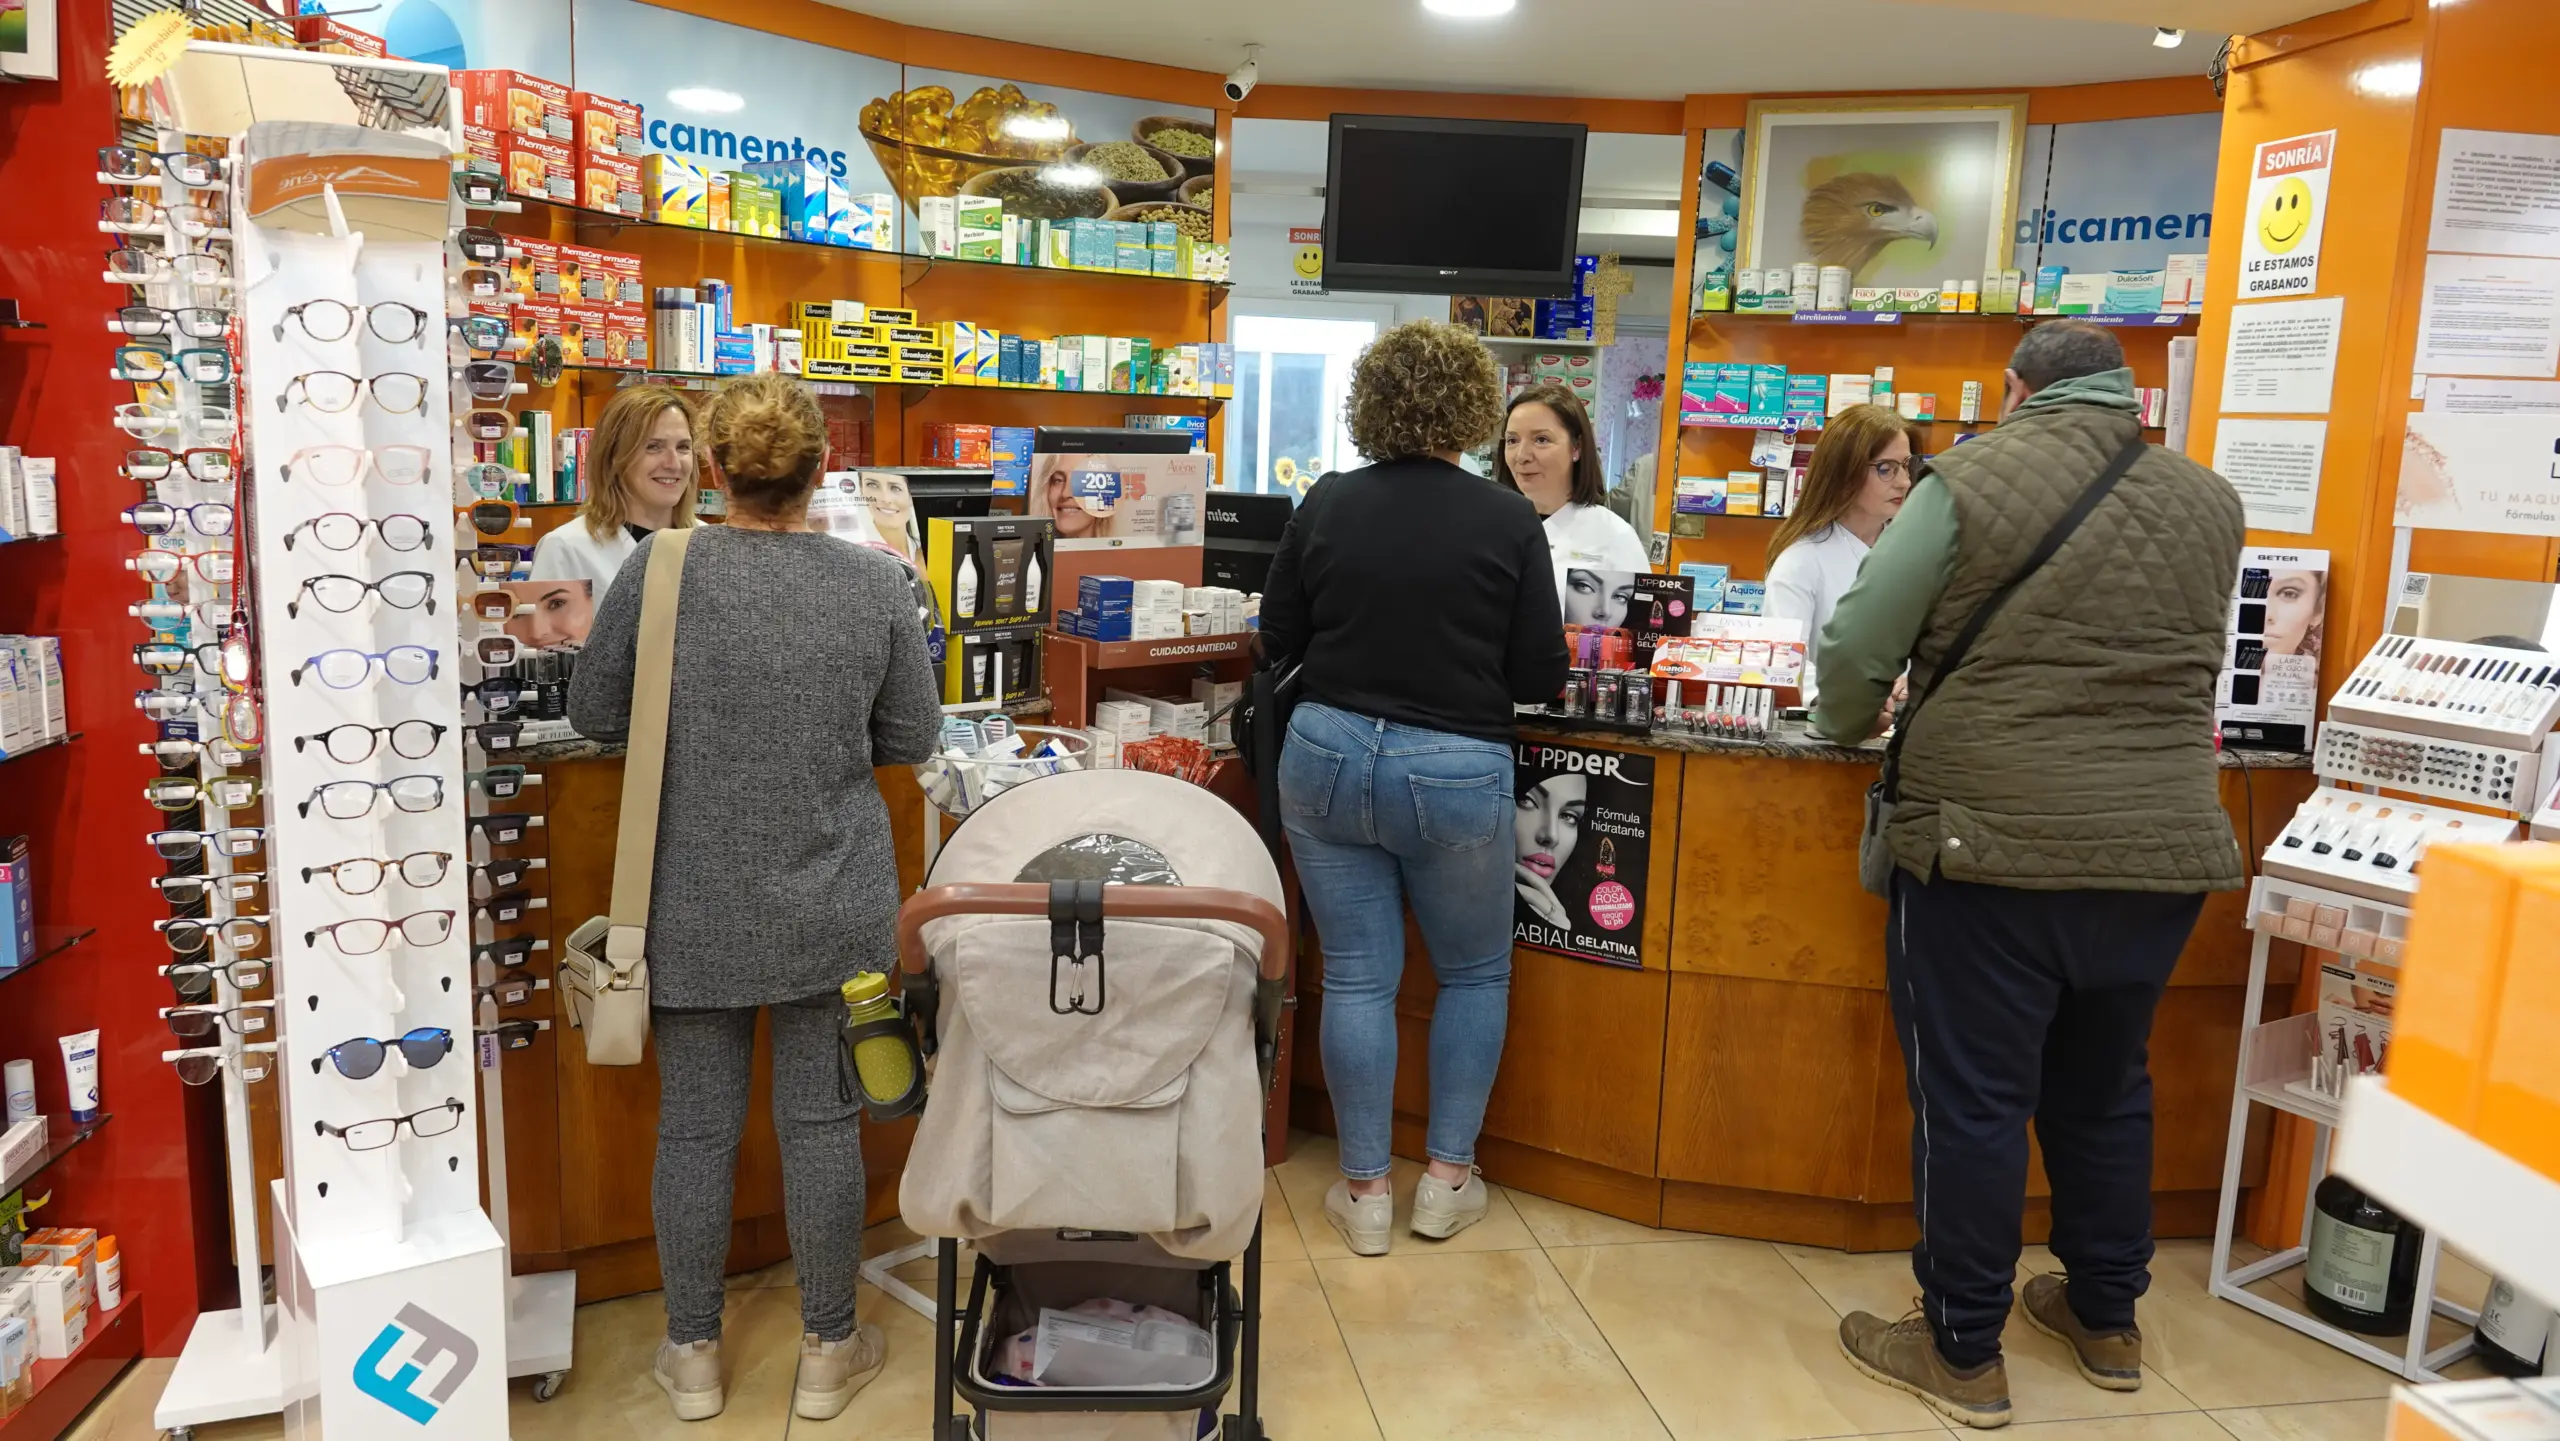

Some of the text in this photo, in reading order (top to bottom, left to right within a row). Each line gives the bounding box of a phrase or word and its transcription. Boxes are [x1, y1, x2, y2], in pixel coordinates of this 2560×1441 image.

[144, 20, 182, 58] presbicia
[326, 21, 383, 49] ThermaCare
[515, 73, 568, 97] ThermaCare
[590, 95, 638, 116] ThermaCare
[635, 100, 848, 178] icamentos
[516, 135, 570, 158] ThermaCare
[2265, 143, 2324, 171] SONRÍA
[592, 154, 639, 173] ThermaCare
[1293, 231, 1320, 241] SONR
[513, 238, 558, 253] ThermaCare
[561, 246, 603, 260] ThermaCare
[603, 255, 641, 266] ermaCare
[2248, 255, 2314, 272] LE ESTAMOS
[2117, 275, 2154, 283] DulcoSoft
[2250, 277, 2309, 292] GRABANDO
[517, 303, 560, 315] ThermaCare
[564, 307, 604, 319] ThermaCare
[806, 304, 832, 315] Thromboc
[608, 312, 647, 324] ThermaCare
[870, 311, 900, 321] Thrombocid
[1794, 313, 1847, 322] Estreñimiento
[2068, 315, 2124, 324] reñimiento
[832, 324, 862, 335] Thrombocid
[891, 328, 921, 340] Thrombocid
[848, 344, 878, 355] Thrombocid
[901, 347, 931, 359] Thrombocid
[809, 362, 844, 373] Thrombocid
[853, 363, 879, 373] hrombocid
[902, 366, 931, 378] Thrombocid
[1187, 420, 1205, 428] ilvico
[1730, 415, 1779, 426] GAVISCON
[1167, 459, 1197, 474] Avène
[2480, 491, 2498, 502] TU
[1207, 508, 1240, 523] nilox
[2505, 510, 2555, 522] Fórmulas
[2257, 554, 2298, 562] BETER
[1730, 585, 1765, 596] Aquora
[1149, 641, 1238, 658] CUIDADOS ANTIEDAD
[1657, 664, 1692, 674] Juanola
[1596, 807, 1641, 824] Fórmula
[1591, 820, 1646, 838] hidratante
[1596, 885, 1624, 894] COLOR
[1595, 891, 1627, 904] ROSA
[1601, 911, 1624, 920] según
[1604, 918, 1612, 926] tu
[1513, 922, 1637, 957] ABIAL GELATINA
[64, 1280, 76, 1293] ISDIN
[6, 1329, 24, 1346] ISDIN
